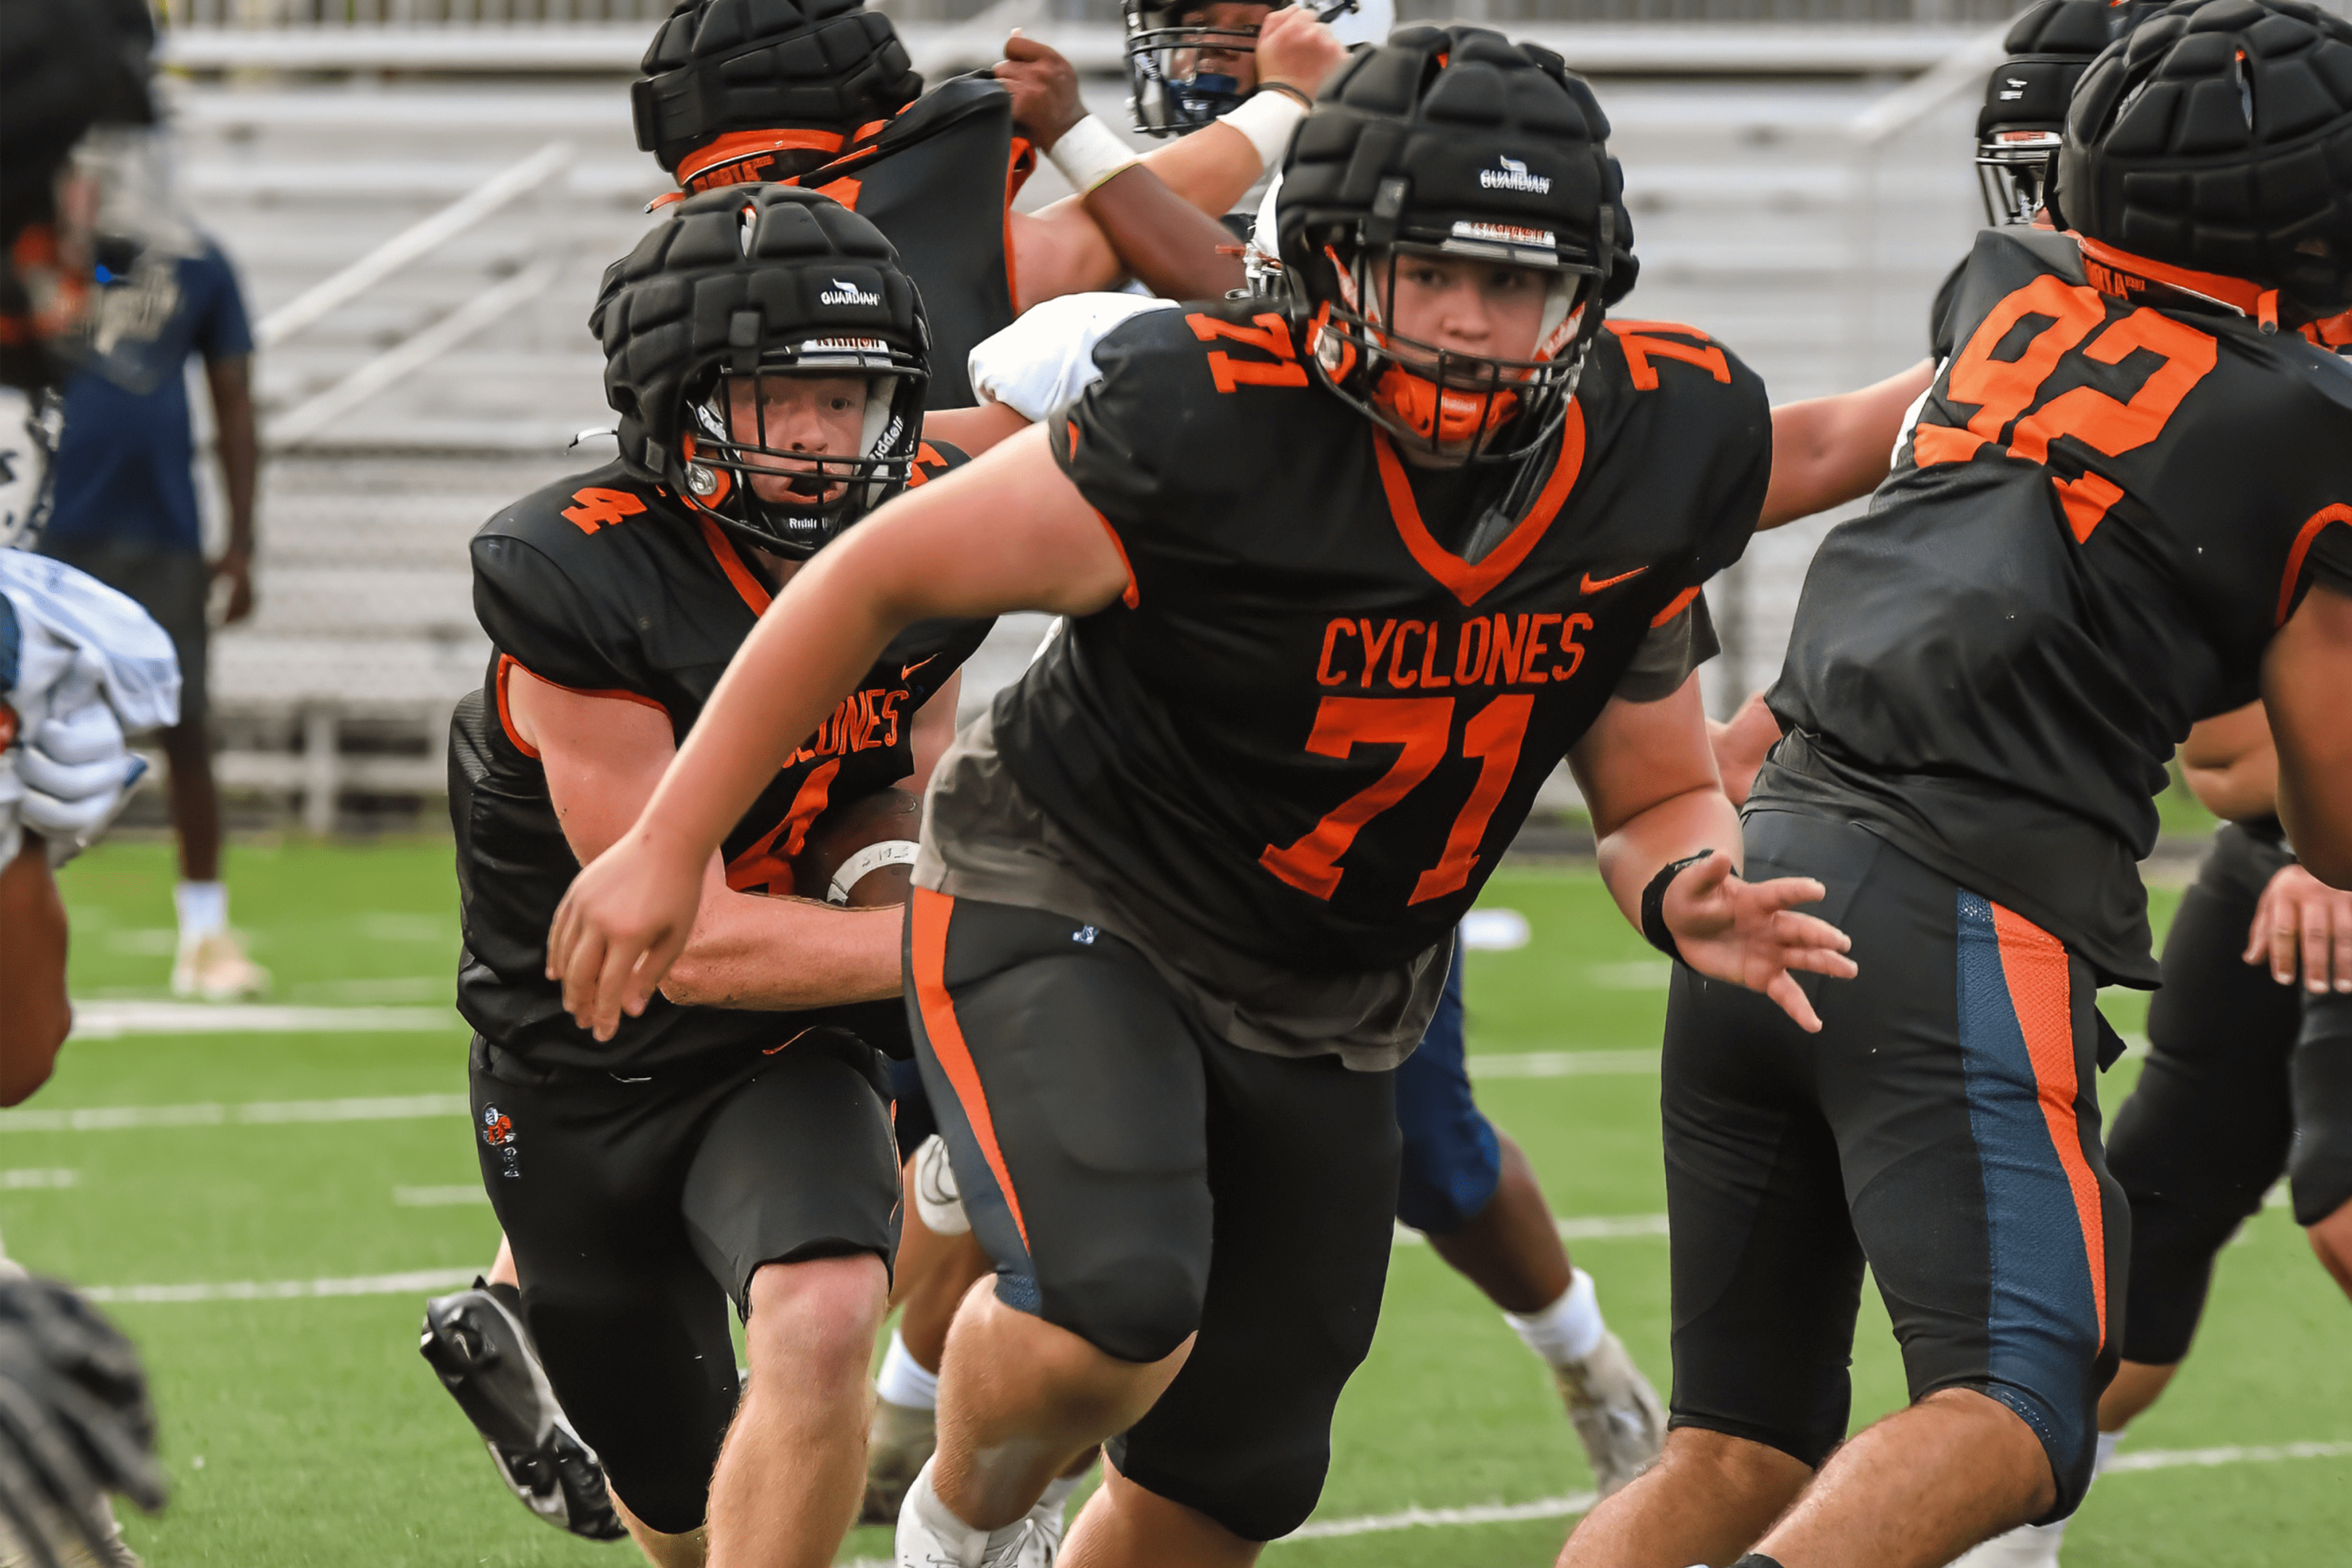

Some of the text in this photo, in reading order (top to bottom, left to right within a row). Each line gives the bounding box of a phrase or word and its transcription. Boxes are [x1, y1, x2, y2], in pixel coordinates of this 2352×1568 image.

[1185, 312, 1309, 393] 71
[1601, 319, 1732, 391] 71
[1316, 612, 1594, 689] CYCLONES
[1258, 693, 1535, 907] 71
